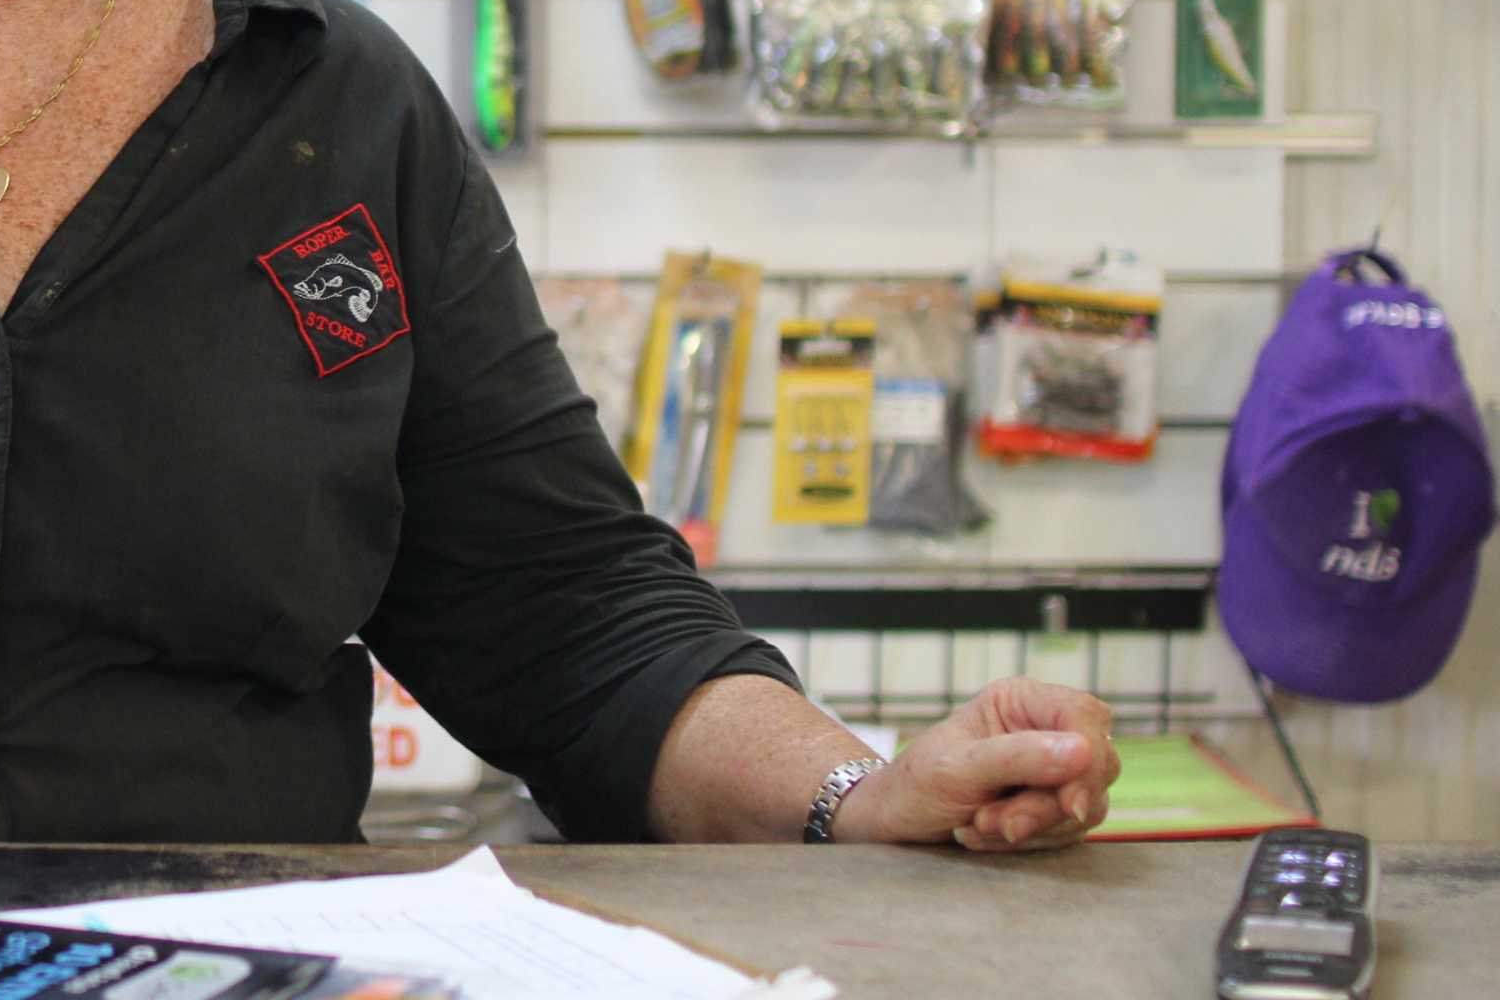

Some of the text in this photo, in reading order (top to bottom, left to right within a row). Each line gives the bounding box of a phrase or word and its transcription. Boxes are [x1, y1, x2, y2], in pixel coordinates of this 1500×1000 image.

[294, 226, 350, 258] ROPER
[370, 251, 395, 290] BAR
[307, 313, 367, 348] STORE
